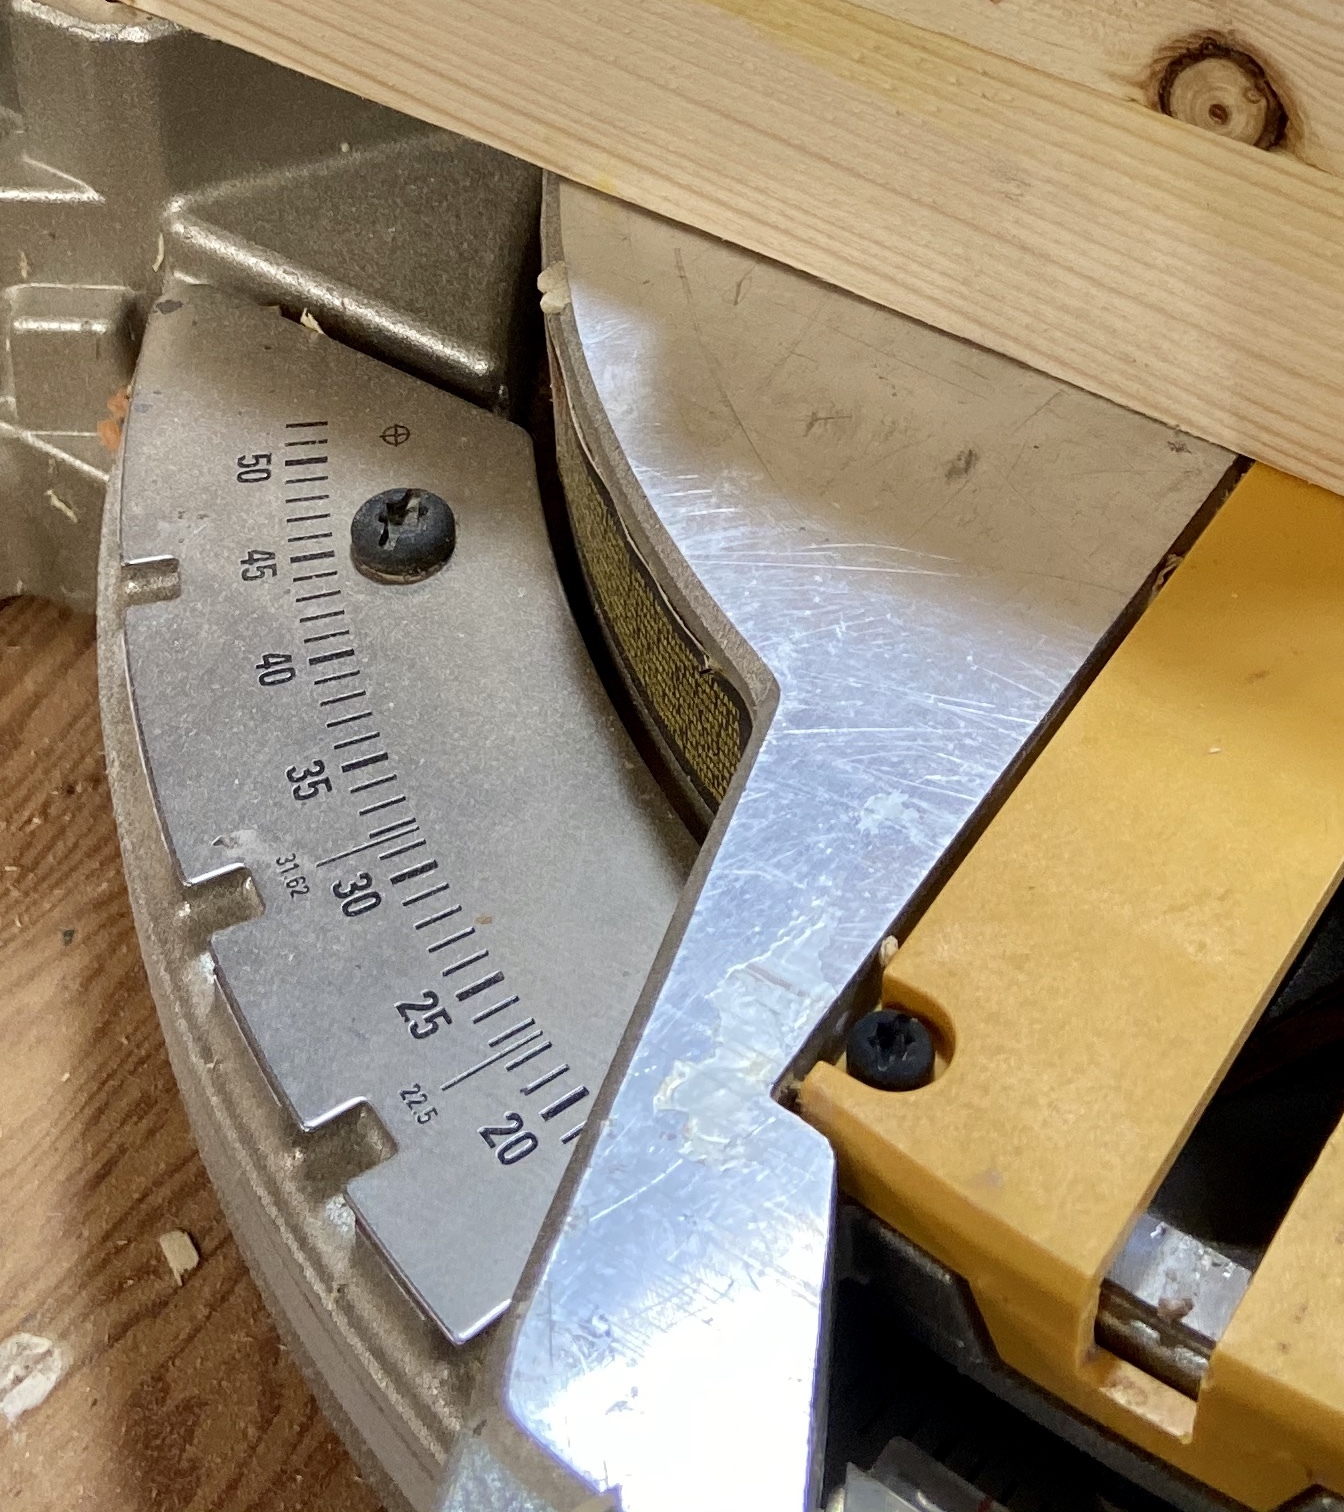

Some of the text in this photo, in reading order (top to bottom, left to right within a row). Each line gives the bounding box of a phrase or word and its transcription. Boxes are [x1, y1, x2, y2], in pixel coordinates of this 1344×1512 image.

[236, 452, 272, 483] 50
[240, 549, 278, 581] 45
[256, 652, 296, 686] 40
[285, 759, 333, 801] 35
[276, 852, 310, 899] 31.62
[331, 872, 382, 917] 30
[393, 989, 453, 1039] 25
[397, 1083, 439, 1125] 22.5
[477, 1111, 538, 1165] 20
